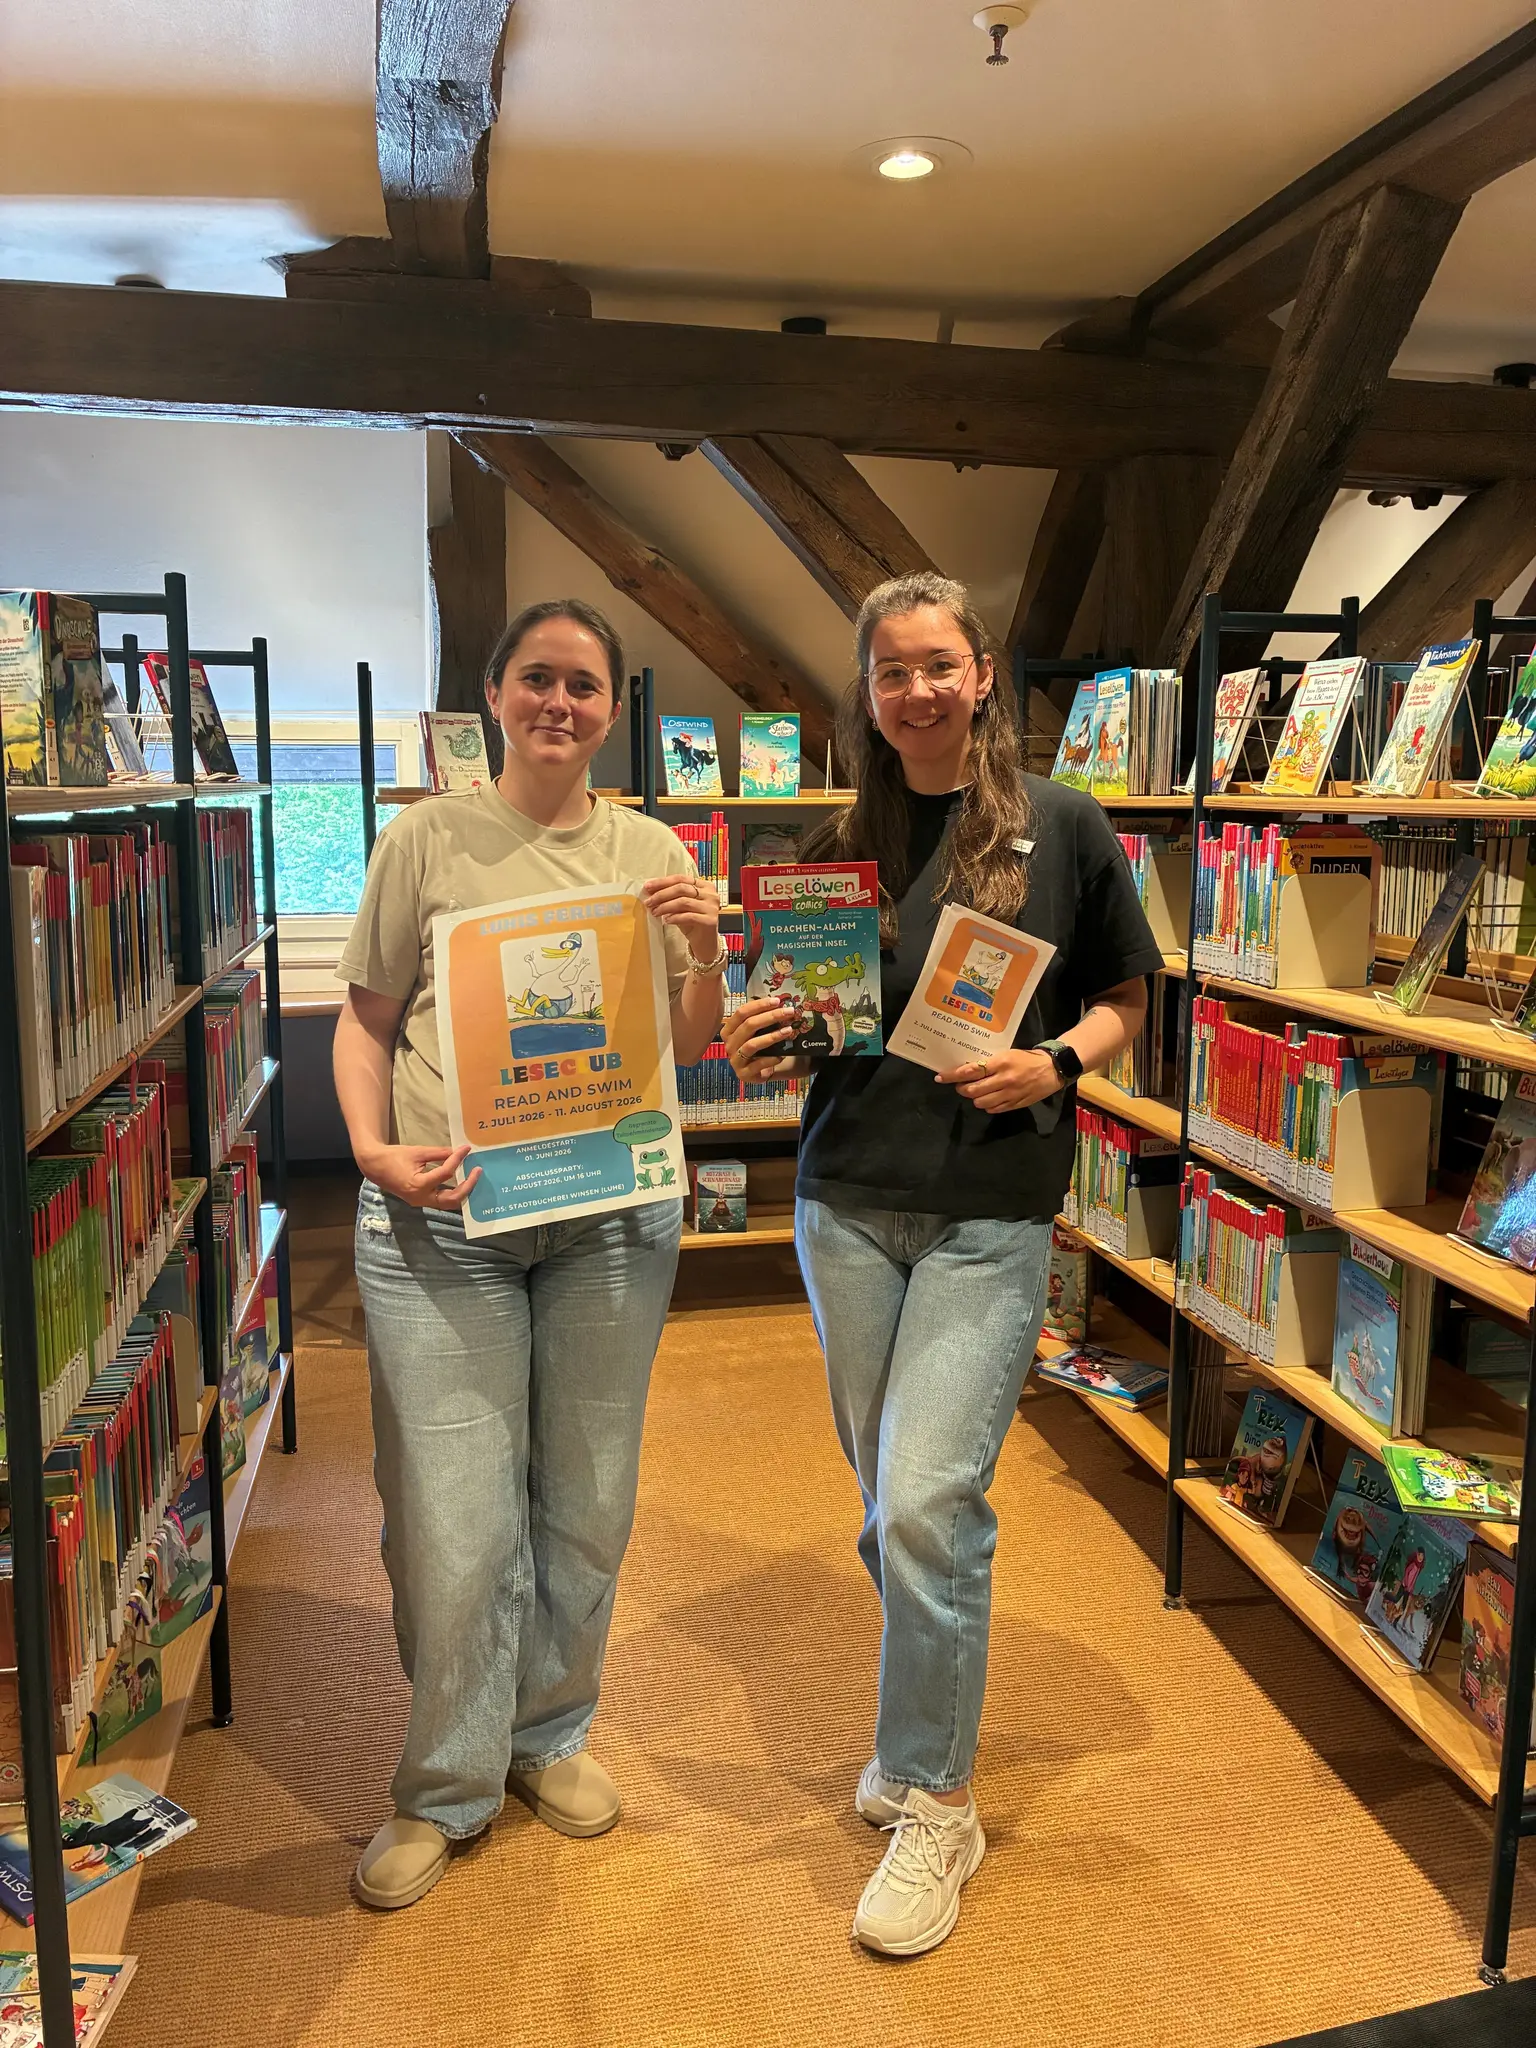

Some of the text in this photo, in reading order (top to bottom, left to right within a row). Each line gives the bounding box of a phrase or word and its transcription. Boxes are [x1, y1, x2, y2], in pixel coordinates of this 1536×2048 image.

[668, 720, 708, 728] OSTWIND
[1312, 863, 1360, 874] DUDEN
[763, 877, 855, 896] Leselöwen
[479, 901, 624, 936] LUHIS FERIEN
[770, 922, 856, 934] DRACHEN-ALARM
[777, 939, 848, 949] MAGISCHEN INSEL
[931, 1010, 991, 1040] READ AND SWIM
[919, 1022, 932, 1032] JULI
[933, 1029, 946, 1039] 2026
[957, 1040, 980, 1053] AUGUST
[1360, 1040, 1425, 1056] Leselöwen
[500, 1052, 622, 1086] LESECLUB
[494, 1078, 632, 1110] READ AND SWIM
[478, 1121, 488, 1130] 2.
[491, 1115, 516, 1128] JULI
[519, 1111, 545, 1124] 2026
[555, 1108, 567, 1117] 11.
[570, 1100, 614, 1115] AUGUST
[616, 1096, 643, 1107] 2026
[516, 1138, 577, 1154] ANMELDESTART:
[535, 1151, 553, 1160] JUNI
[554, 1148, 572, 1157] 2026
[512, 1180, 542, 1192] AUGUST
[563, 1174, 575, 1182] UM
[586, 1169, 602, 1178] UHR
[516, 1164, 584, 1181] ABSCHLUSSPARTY:
[482, 1205, 507, 1216] INFOS:
[570, 1187, 600, 1200] WINSEN
[601, 1183, 625, 1194] (LUHE)
[1244, 1431, 1261, 1448] Dino
